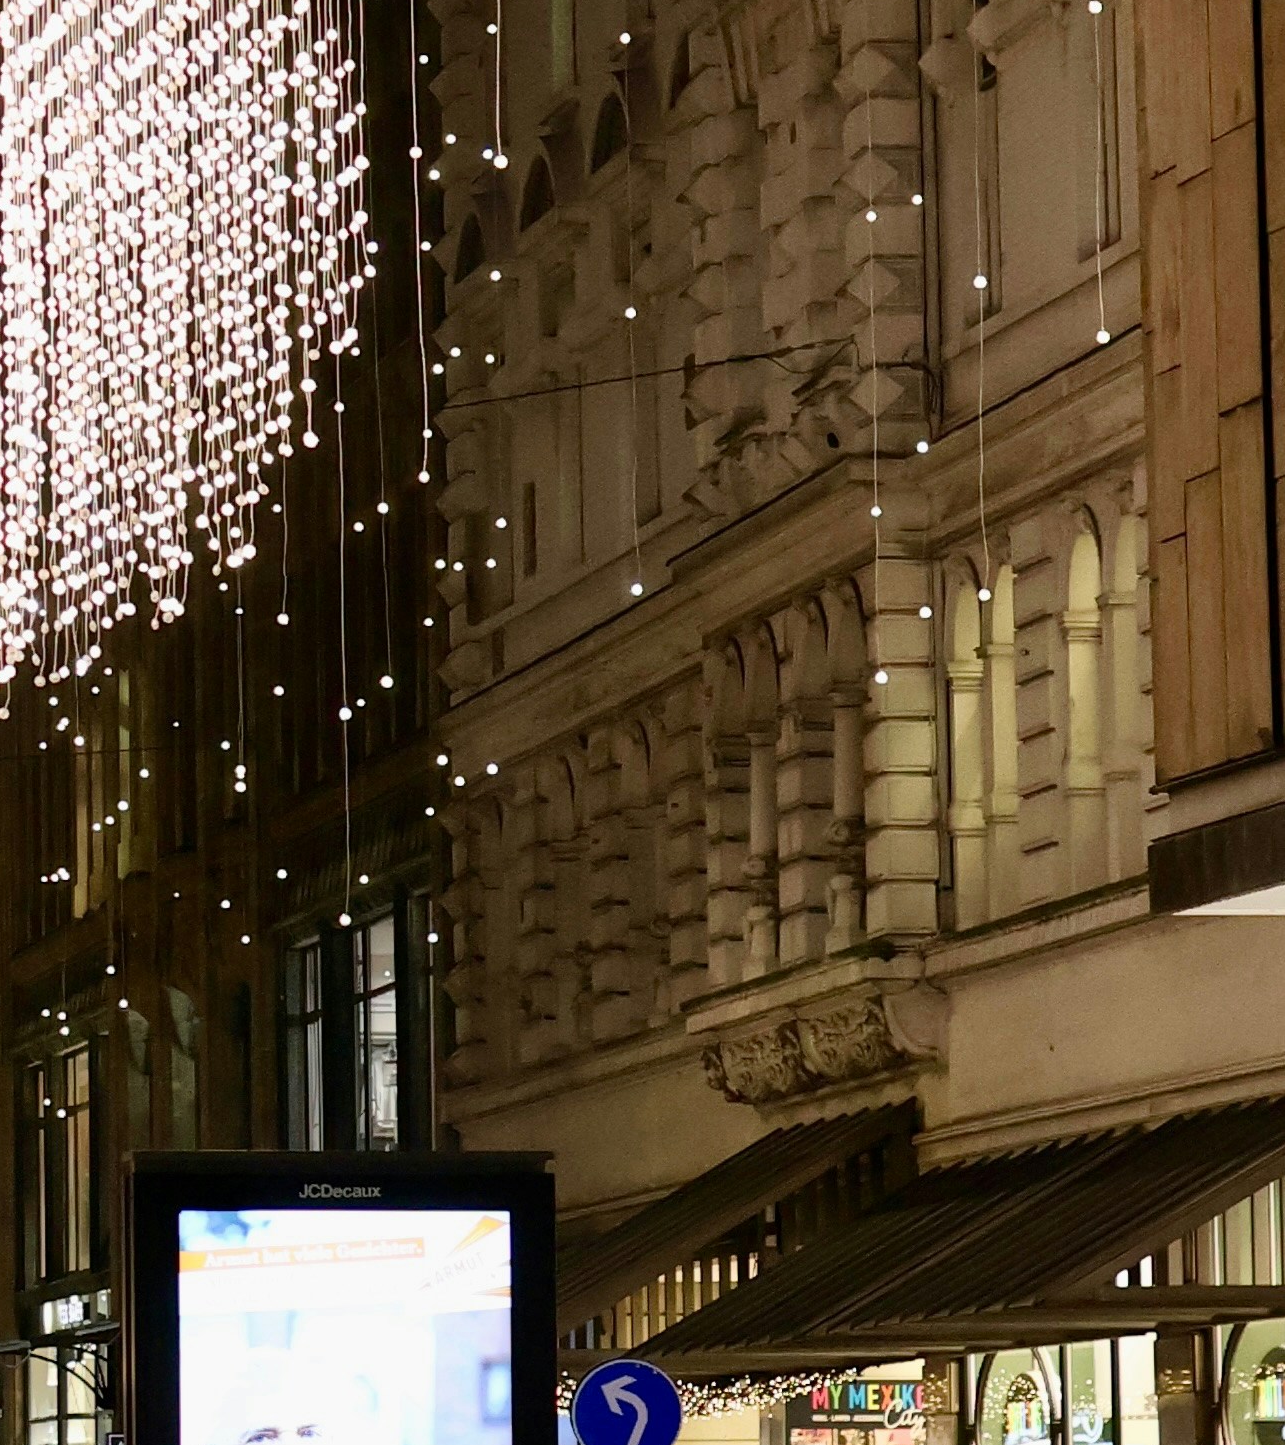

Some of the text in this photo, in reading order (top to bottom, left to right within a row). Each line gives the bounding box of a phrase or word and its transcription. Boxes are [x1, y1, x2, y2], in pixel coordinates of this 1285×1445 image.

[298, 1183, 382, 1199] JCDecaux
[205, 1250, 260, 1269] Armut
[262, 1247, 291, 1265] hat
[433, 1251, 487, 1286] ARMUT
[812, 1383, 843, 1411] MY
